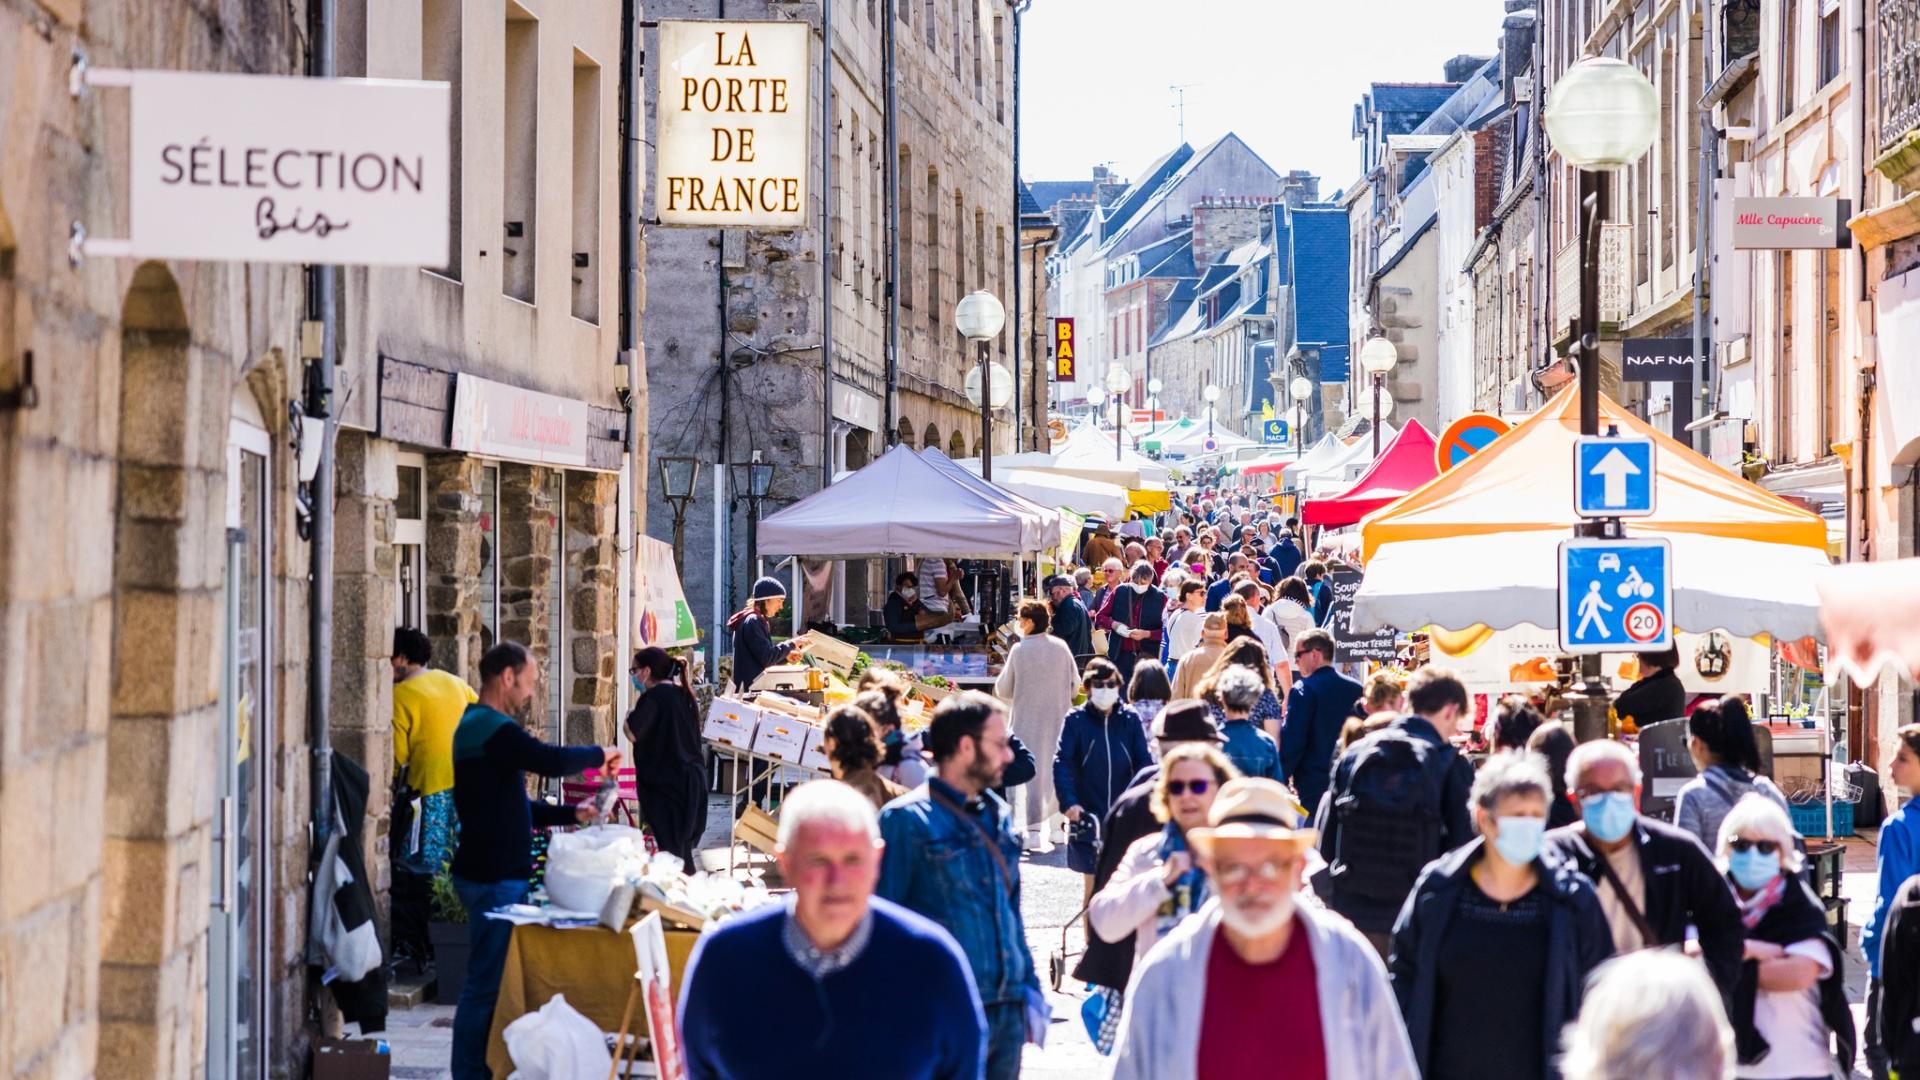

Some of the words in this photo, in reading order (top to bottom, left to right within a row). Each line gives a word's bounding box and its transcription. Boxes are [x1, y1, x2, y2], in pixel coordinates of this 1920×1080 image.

[715, 29, 757, 66] LA
[681, 77, 788, 113] PORTE
[711, 128, 755, 162] DE
[161, 136, 424, 193] SÉLECTION
[666, 175, 800, 213] FRANCE
[255, 196, 350, 240] Bis
[1737, 213, 1763, 225] Mlle
[1766, 213, 1824, 229] Capucine
[1057, 322, 1073, 376] BAR
[1627, 355, 1665, 366] NAF
[1334, 594, 1356, 603] D'AG
[1633, 615, 1654, 629] 20
